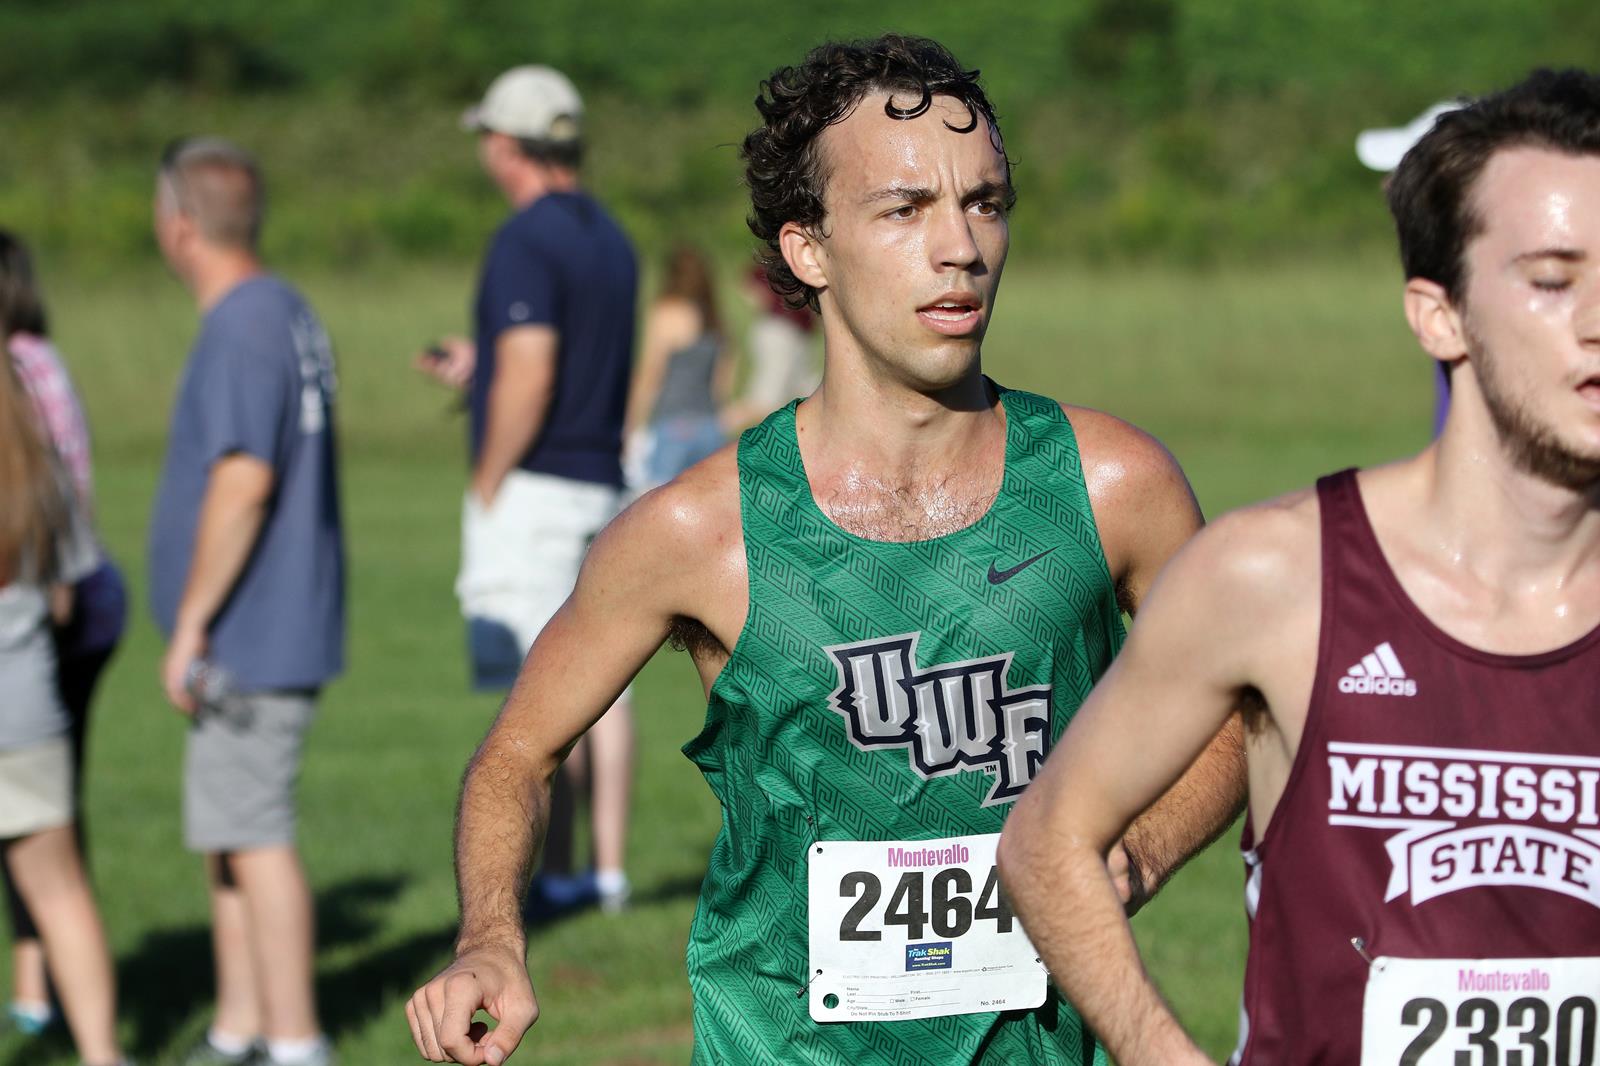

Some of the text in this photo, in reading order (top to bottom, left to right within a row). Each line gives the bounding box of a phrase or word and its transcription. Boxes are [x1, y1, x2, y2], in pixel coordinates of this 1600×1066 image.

[1338, 676, 1417, 697] adidas
[829, 636, 1051, 801] UWF
[887, 844, 969, 867] Montevallo
[1430, 836, 1592, 889] STATE
[839, 866, 1016, 942] 2464
[908, 947, 951, 958] Trak Shak
[1458, 969, 1550, 992] Montevallo
[1399, 996, 1597, 1066] 2330
